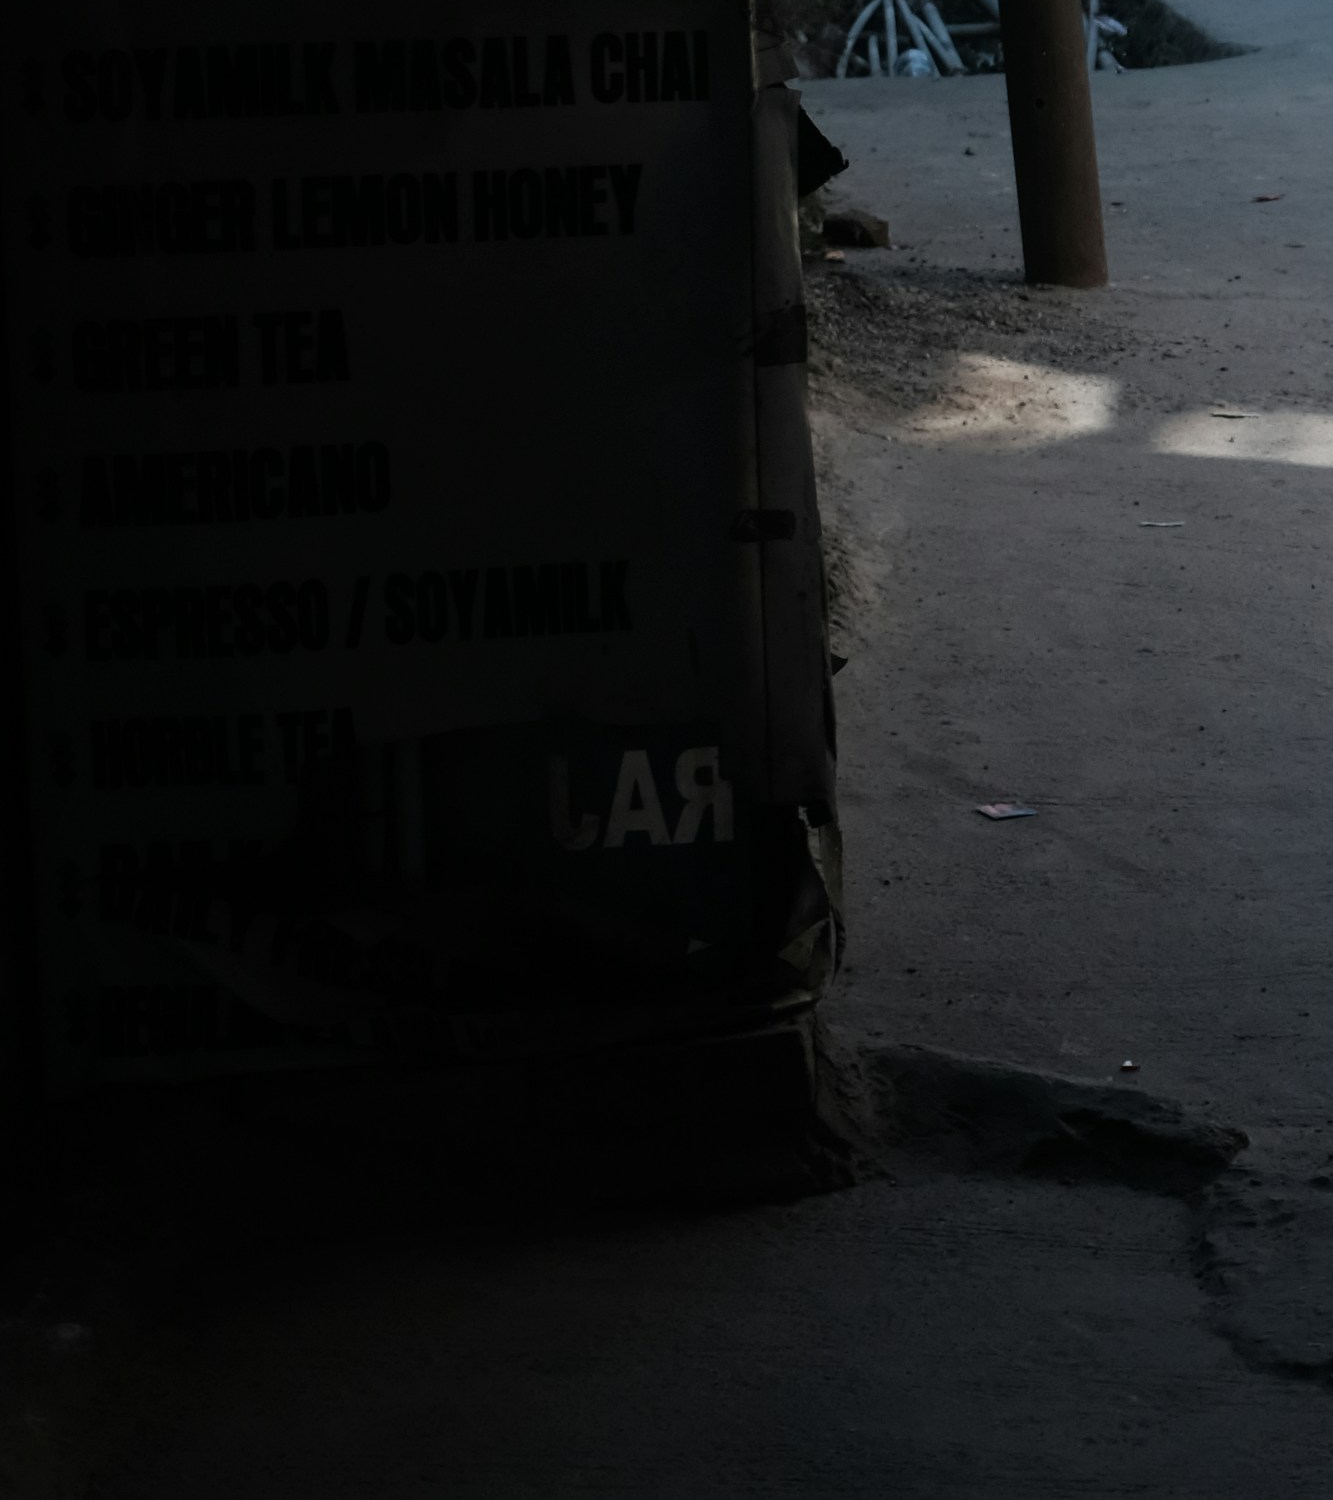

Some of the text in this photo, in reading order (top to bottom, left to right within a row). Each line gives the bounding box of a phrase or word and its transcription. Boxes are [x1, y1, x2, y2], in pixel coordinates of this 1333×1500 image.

[62, 29, 711, 123] SOYAMILK MASALA CHAI
[65, 163, 643, 260] GINGER LEMON HONEY
[71, 308, 351, 394] GREEN TEA
[78, 441, 391, 529] AMERICANO
[83, 578, 332, 662] ESPRESSO
[383, 558, 633, 645] SOYAMILK
